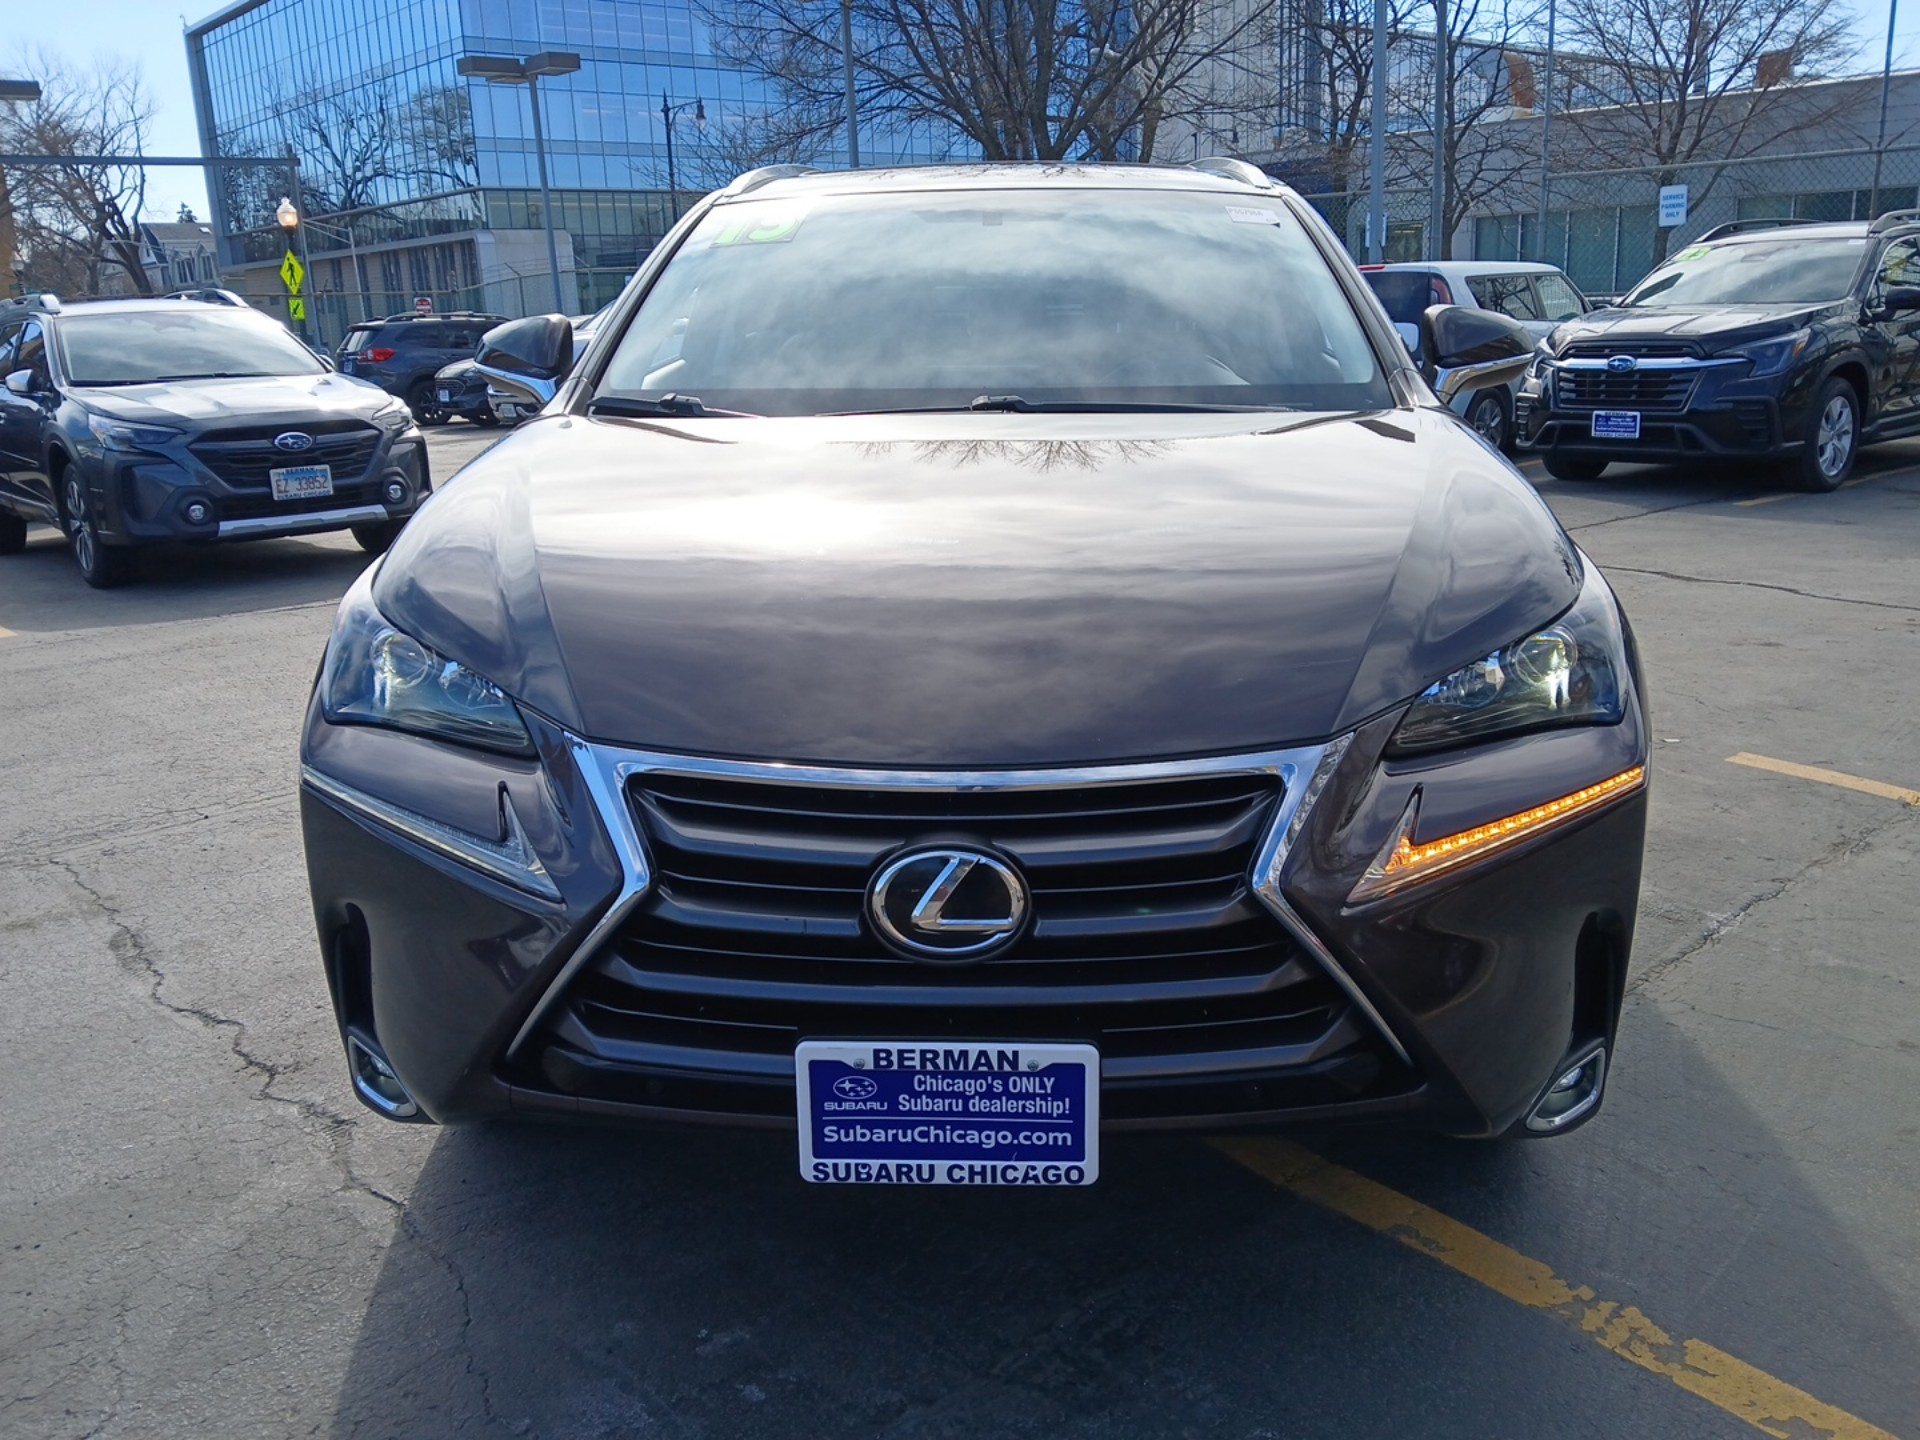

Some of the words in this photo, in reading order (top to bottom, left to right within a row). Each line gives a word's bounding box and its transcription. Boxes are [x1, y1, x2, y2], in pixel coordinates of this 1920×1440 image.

[1661, 202, 1685, 210] PARKING
[1662, 193, 1685, 201] SERVICE
[275, 478, 290, 493] EZ
[294, 475, 329, 491] 33852
[872, 1048, 1020, 1070] BERMAN
[913, 1075, 1003, 1095] Chicago's
[1008, 1076, 1055, 1093] ONLY
[824, 1101, 887, 1110] SUBARU
[898, 1094, 963, 1112] Subaru
[968, 1096, 1070, 1117] dealership!
[823, 1125, 1072, 1149] SubaruChicago.com
[812, 1162, 936, 1183] SUBARU
[946, 1163, 1085, 1185] CHICAGO
